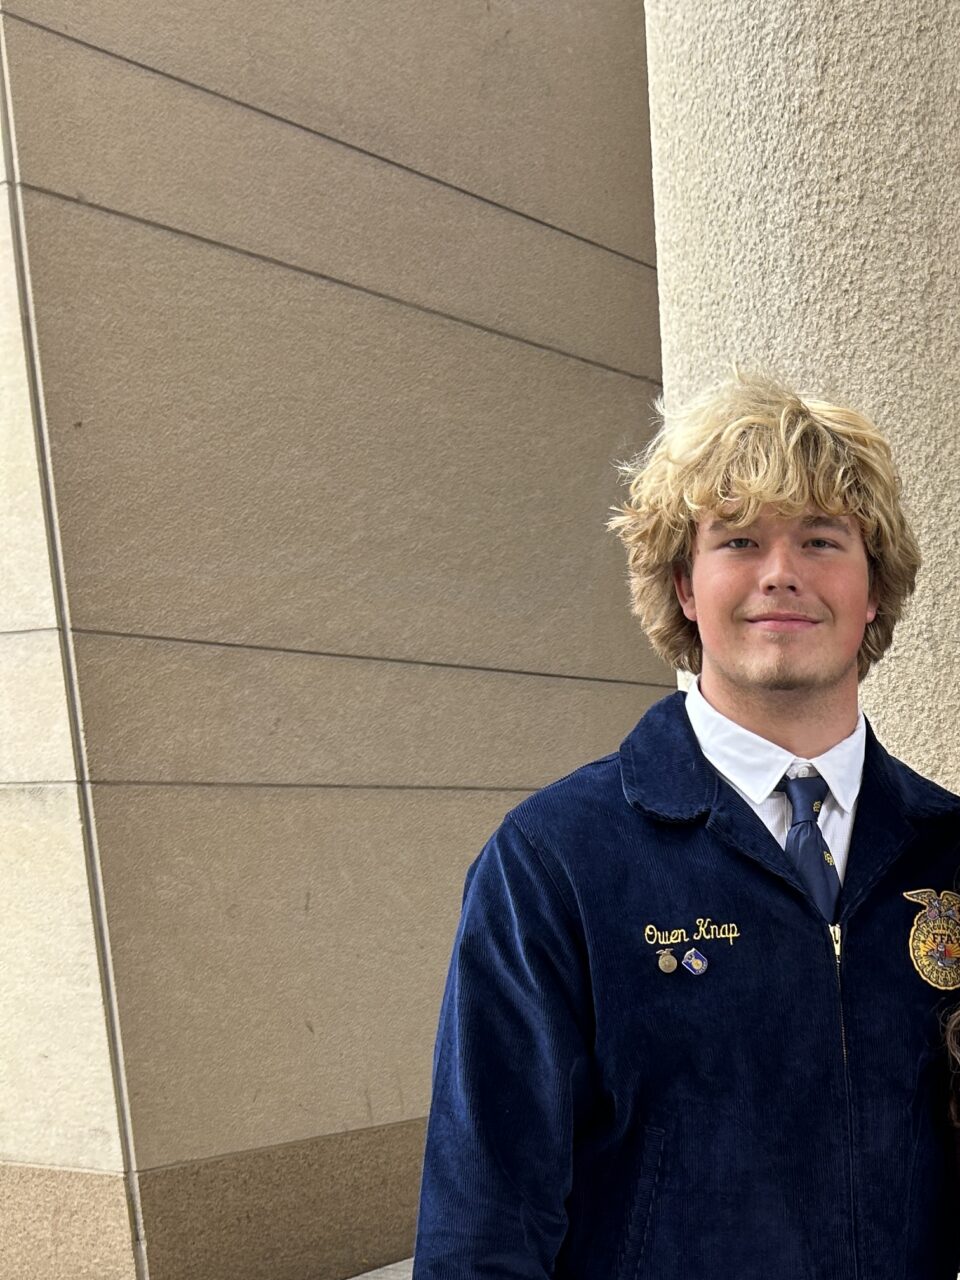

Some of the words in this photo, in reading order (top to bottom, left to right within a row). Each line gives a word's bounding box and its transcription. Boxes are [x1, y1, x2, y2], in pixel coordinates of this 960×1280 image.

[645, 925, 689, 944] Owen
[693, 918, 740, 945] Knap
[932, 933, 954, 944] FFA
